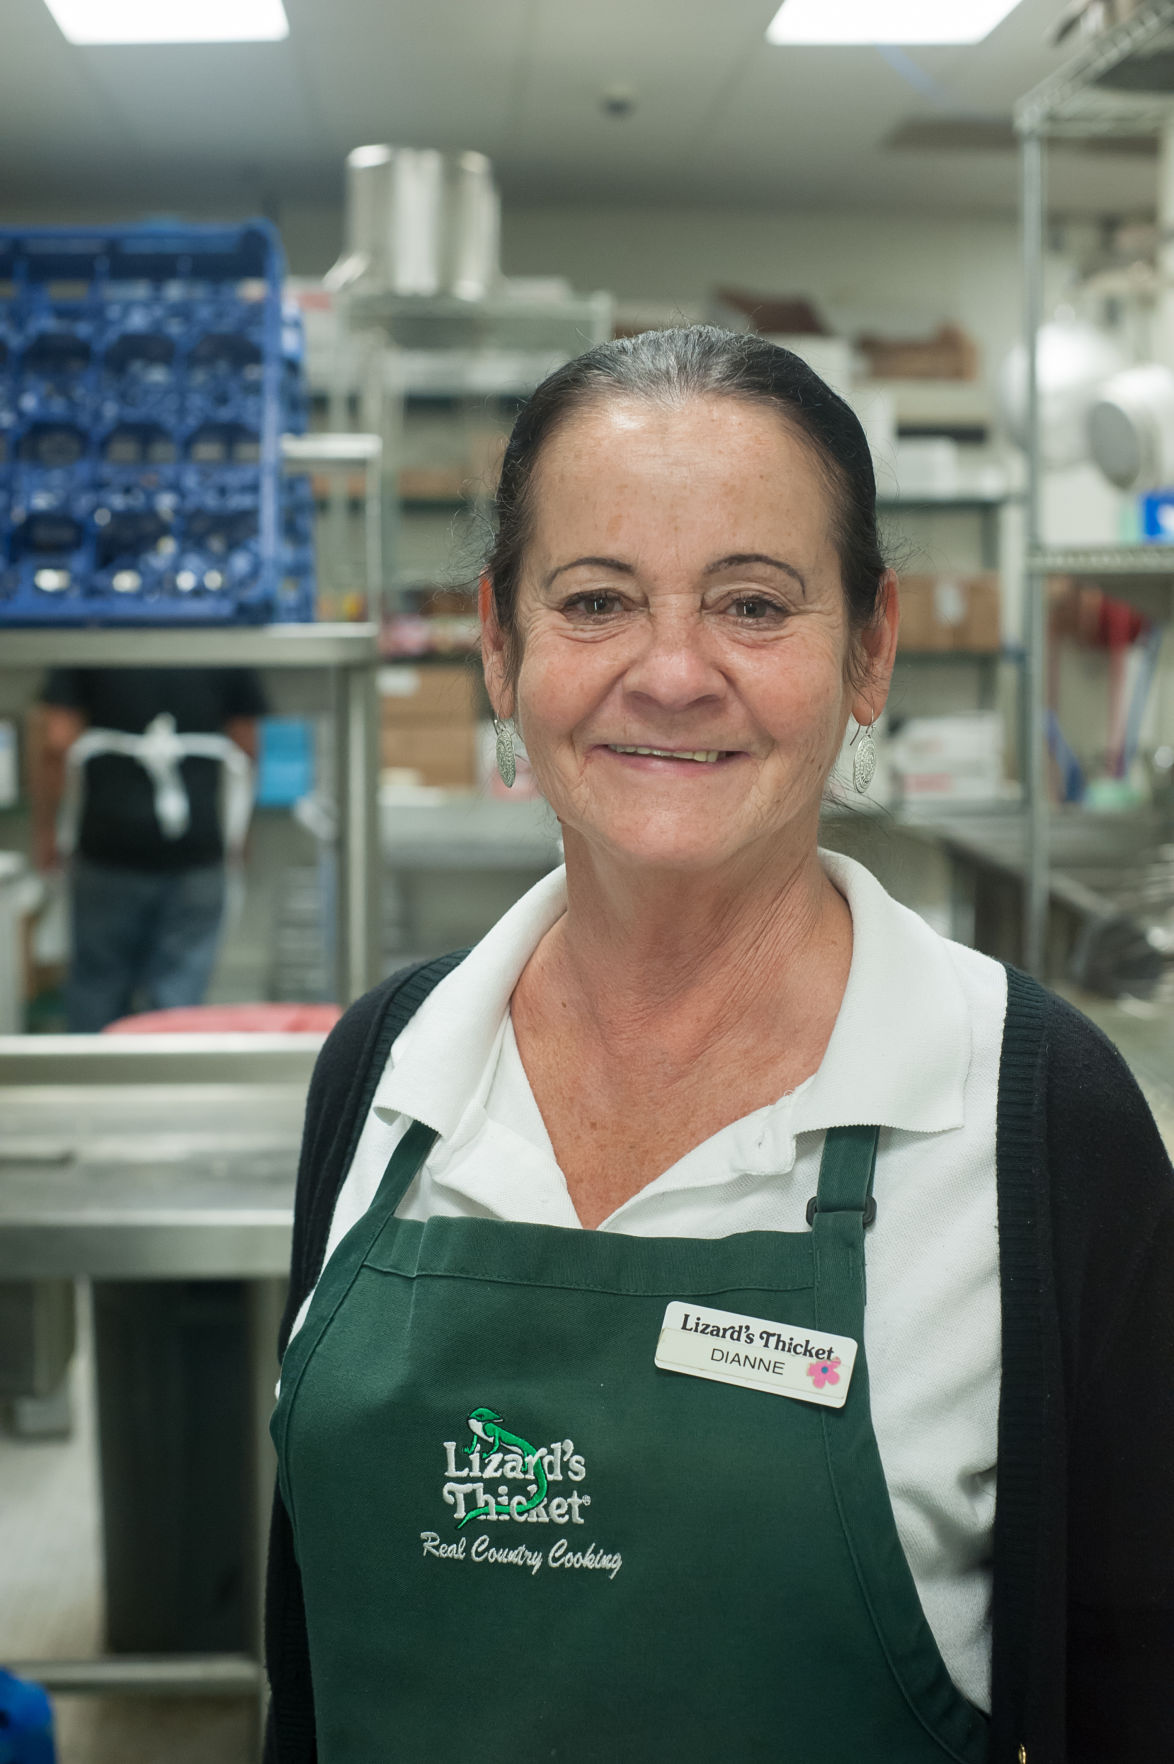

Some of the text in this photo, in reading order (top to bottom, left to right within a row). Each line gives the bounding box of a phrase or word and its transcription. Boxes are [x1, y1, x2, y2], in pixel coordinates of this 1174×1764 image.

[681, 1313, 834, 1361] Lizard's Thicket
[710, 1348, 786, 1376] DIANNE
[443, 1439, 586, 1482] Lizard's
[420, 1531, 623, 1580] Real Country Cooking
